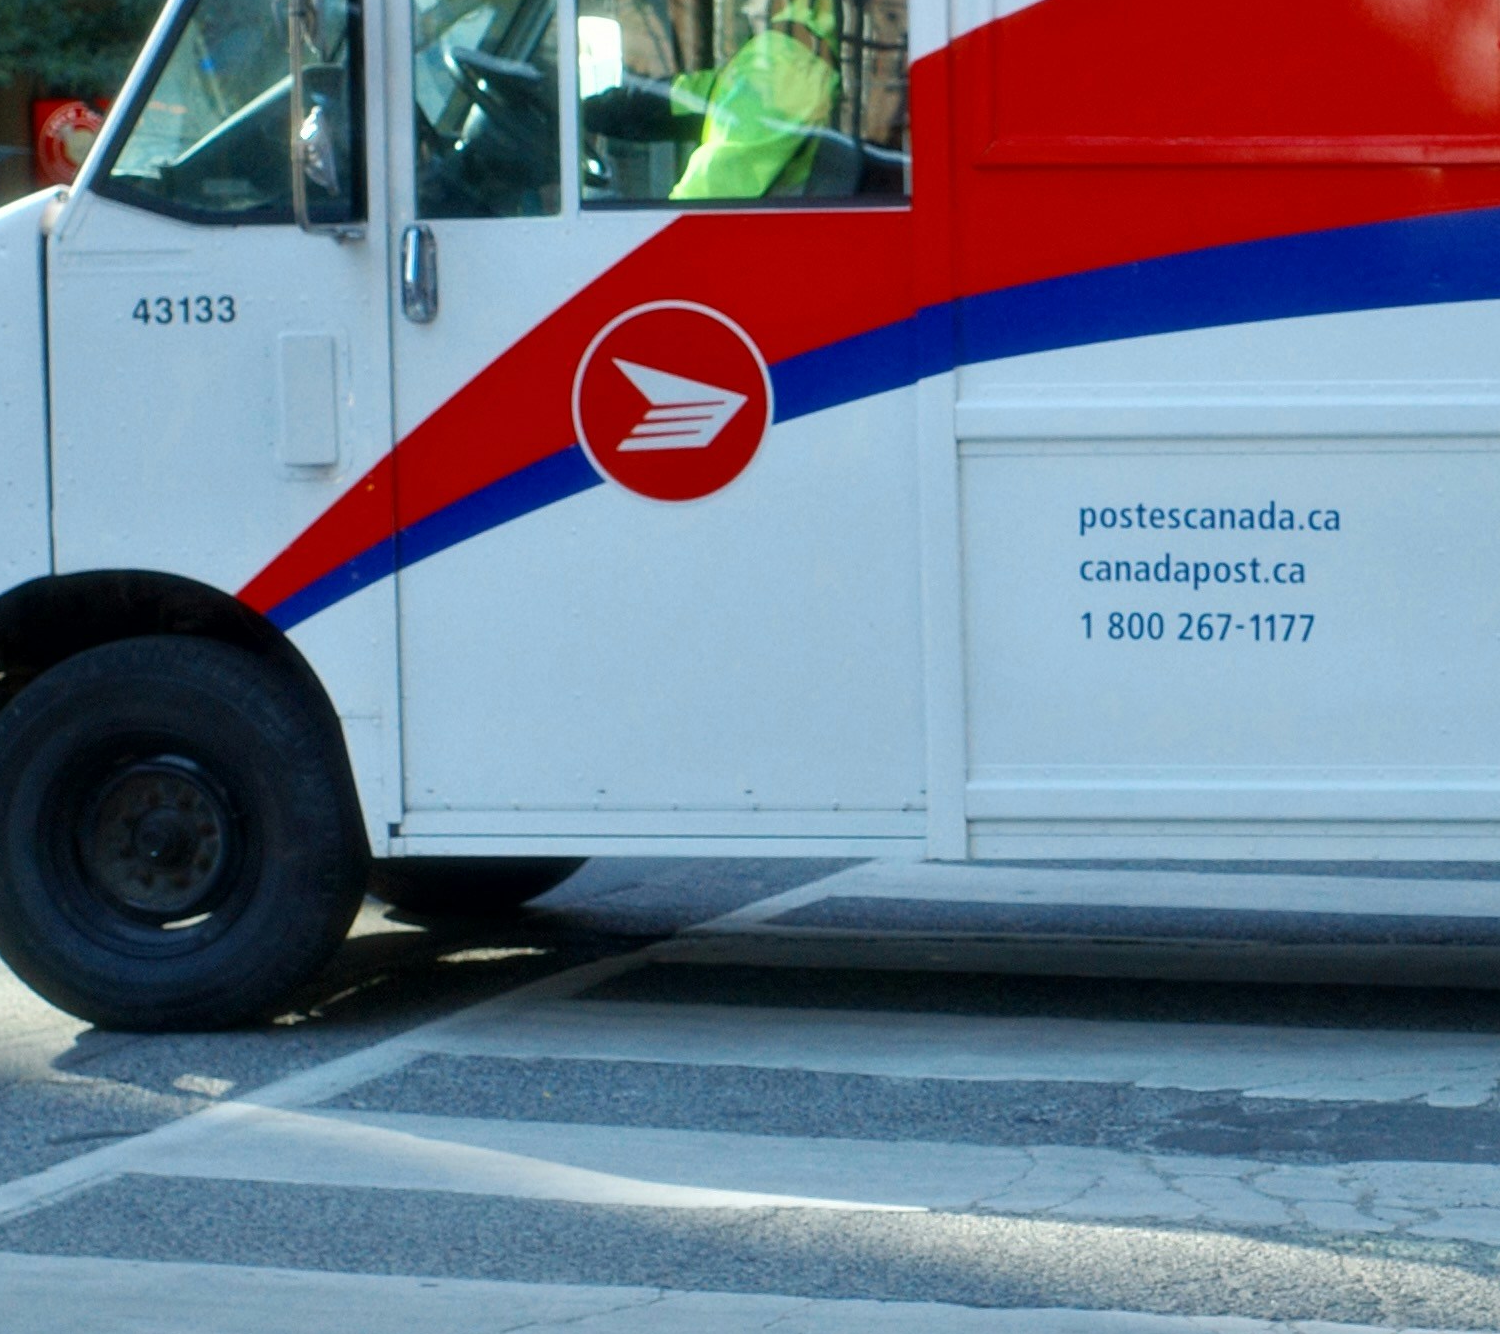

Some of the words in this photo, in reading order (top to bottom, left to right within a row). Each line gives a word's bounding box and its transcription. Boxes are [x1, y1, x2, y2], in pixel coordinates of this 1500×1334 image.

[131, 294, 237, 325] 43133
[1078, 499, 1341, 536] postescanada.ca
[1078, 551, 1307, 591] canadapost.ca
[1080, 611, 1093, 640] 1
[1106, 611, 1166, 641] 800
[1176, 612, 1316, 643] 267-1177
